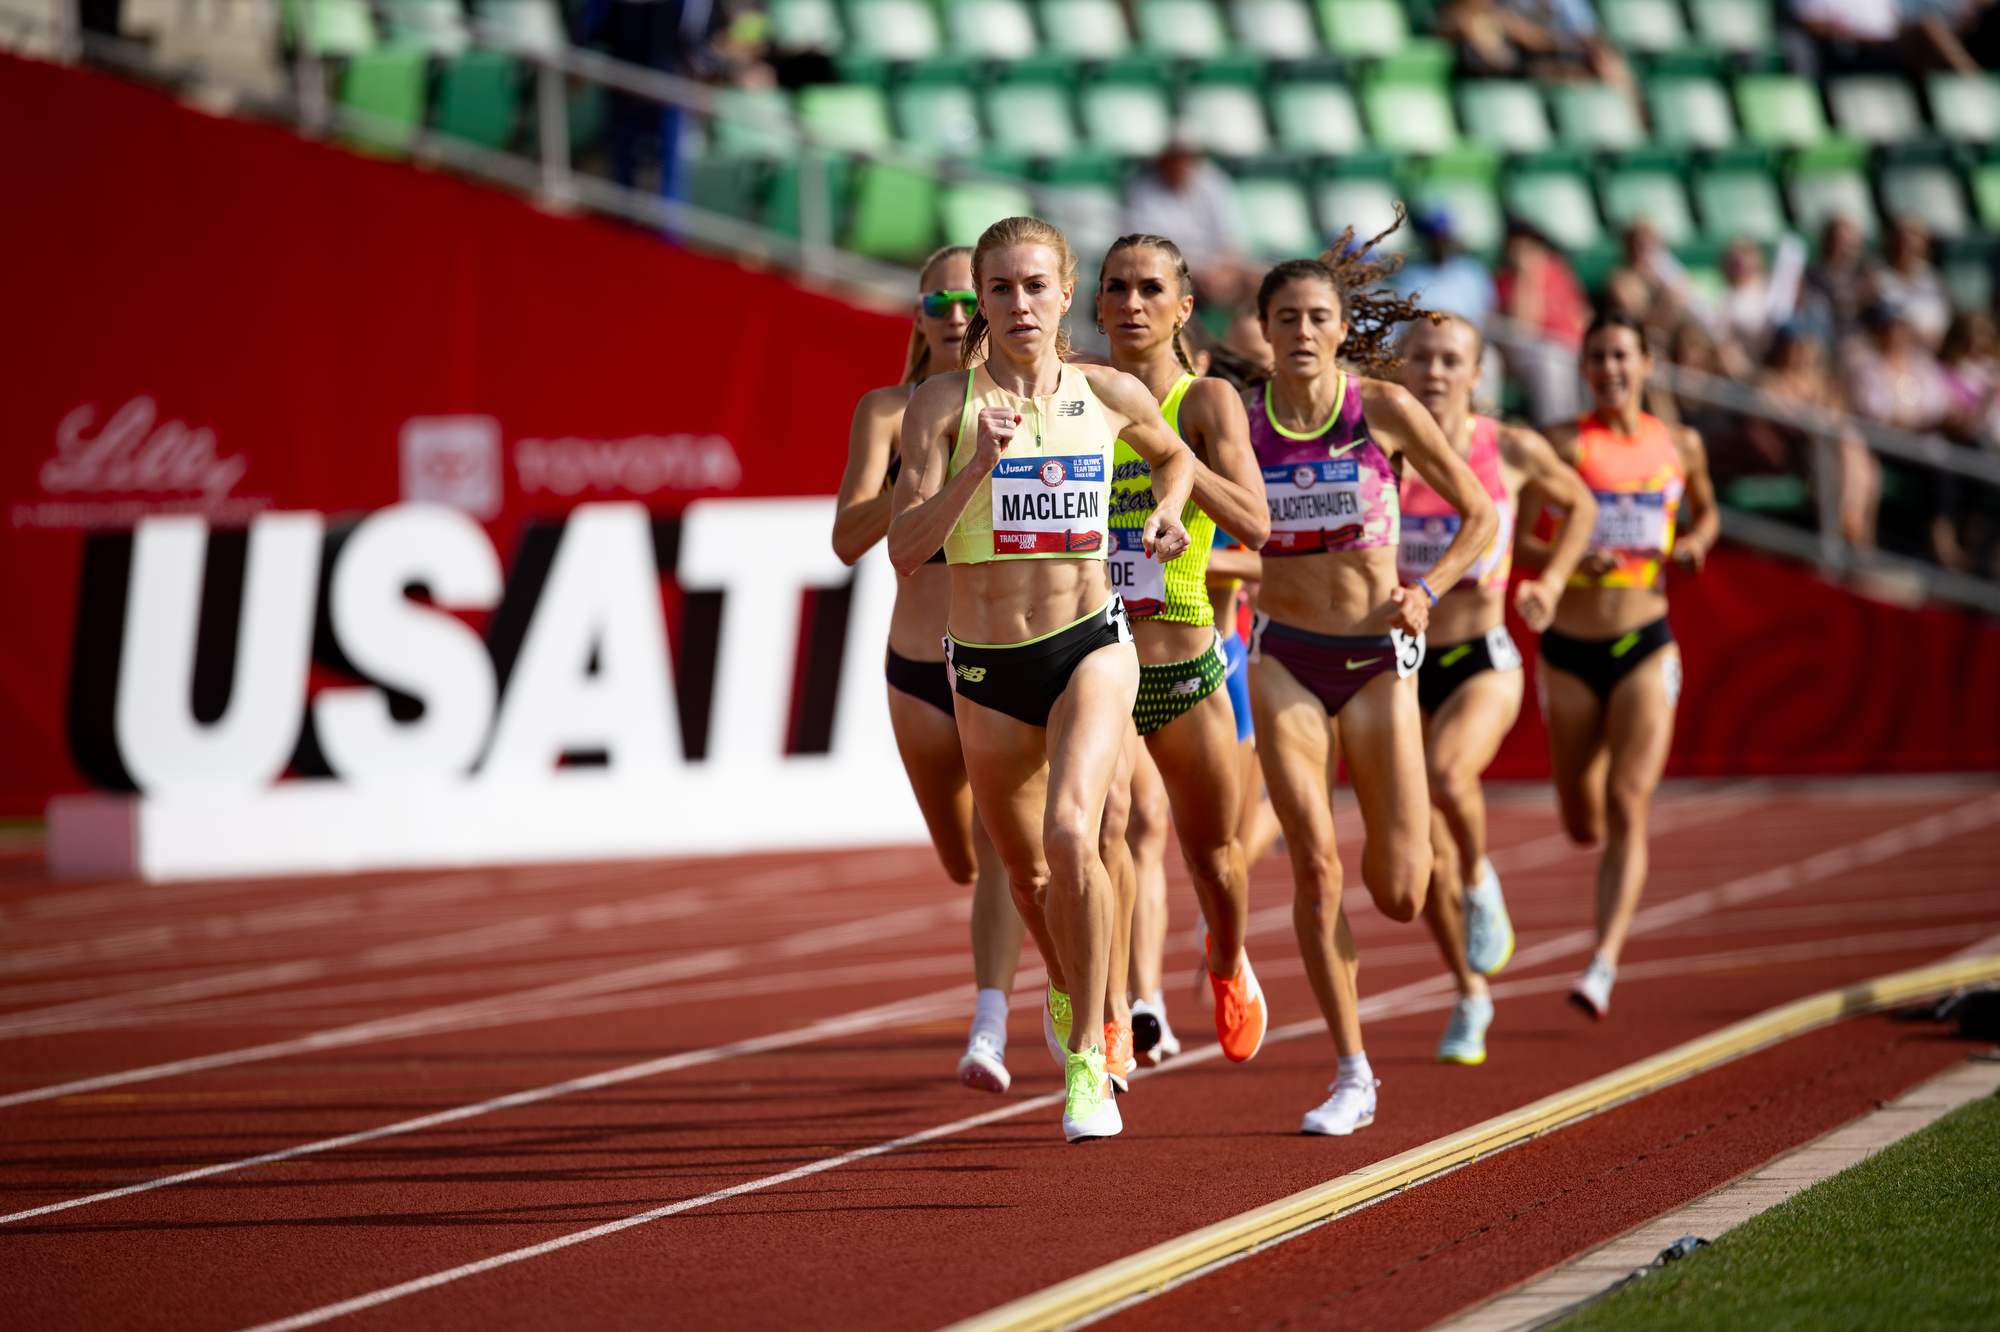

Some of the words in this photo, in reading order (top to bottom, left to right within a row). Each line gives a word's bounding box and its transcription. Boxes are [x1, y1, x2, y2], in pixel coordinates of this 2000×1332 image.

[1010, 465, 1033, 473] USATF
[1111, 459, 1152, 484] ms
[1002, 491, 1099, 521] MACLEAN
[1108, 487, 1158, 519] Stat
[999, 533, 1037, 544] TRACKTOWN
